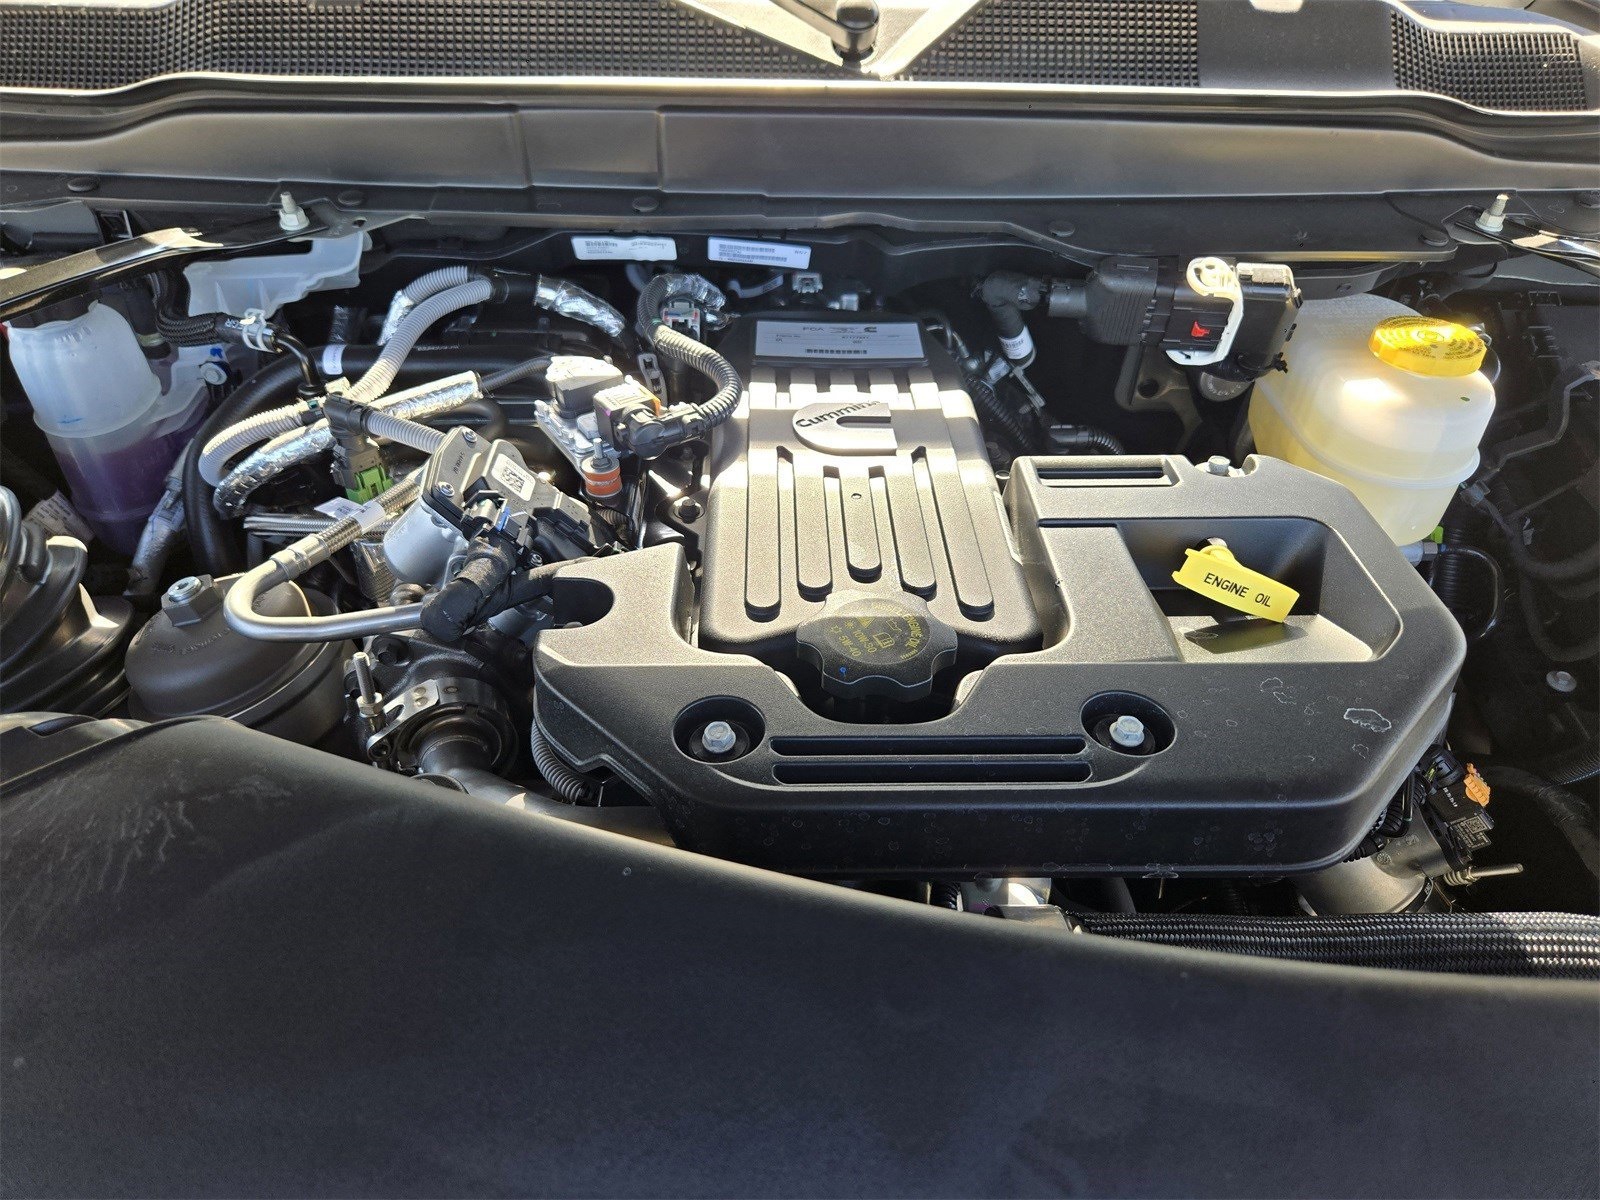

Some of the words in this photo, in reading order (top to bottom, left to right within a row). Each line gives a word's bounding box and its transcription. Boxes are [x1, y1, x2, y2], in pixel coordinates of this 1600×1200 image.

[1203, 572, 1249, 597] ENGINE
[1255, 593, 1271, 607] OIL
[838, 635, 862, 657] 5W-40
